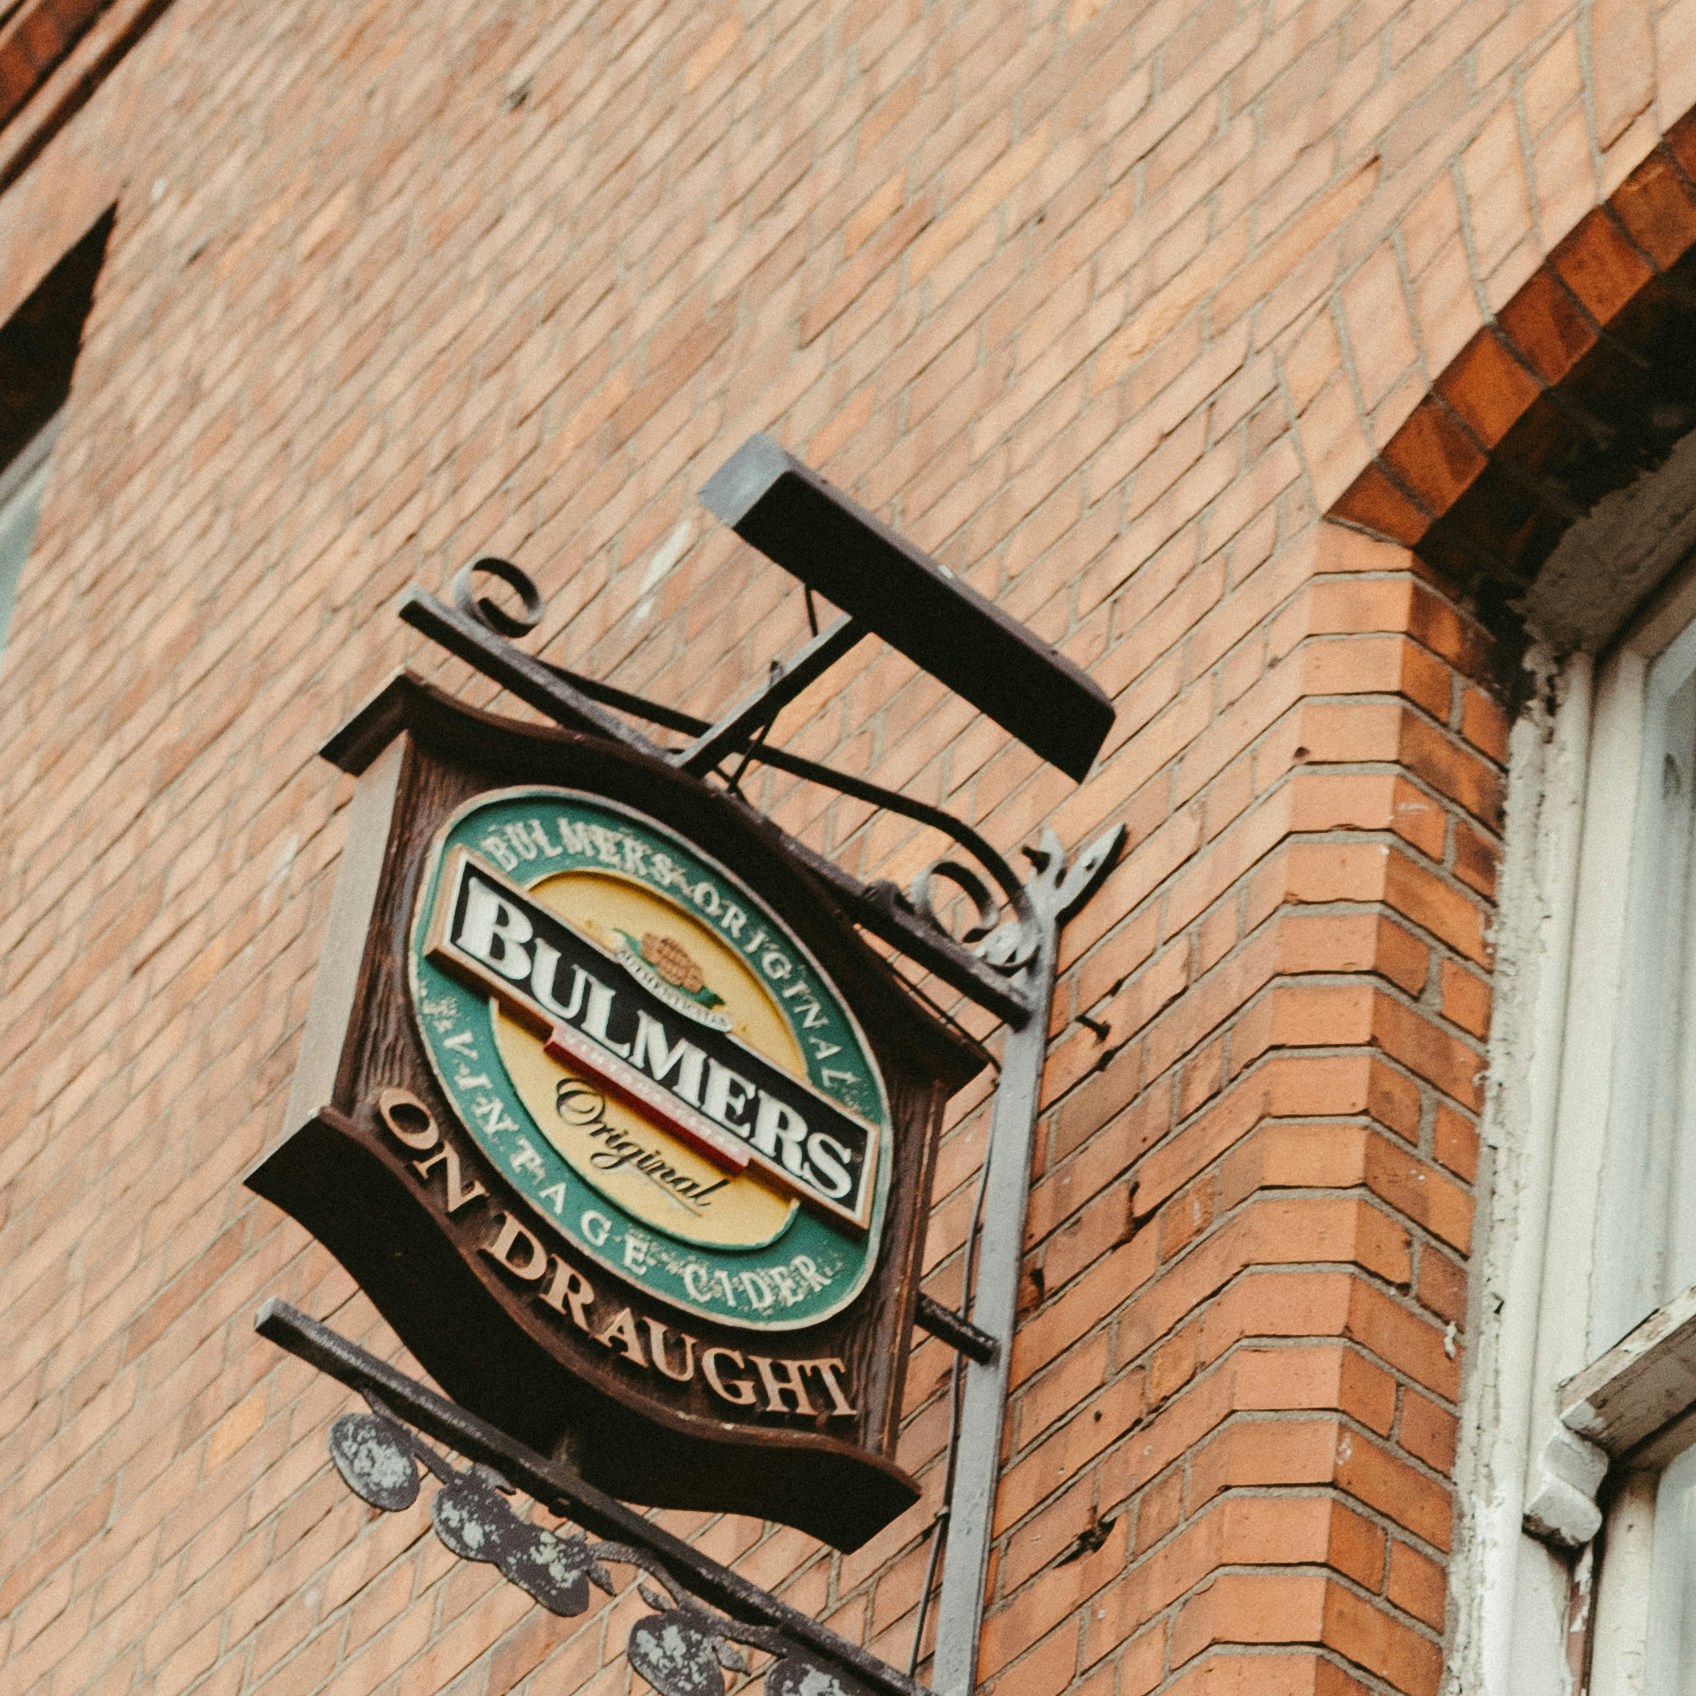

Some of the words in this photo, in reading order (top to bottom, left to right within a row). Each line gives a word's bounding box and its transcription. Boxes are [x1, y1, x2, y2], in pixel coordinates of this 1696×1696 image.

[456, 875, 855, 1200] BULMERS
[481, 815, 674, 886] BULMERS
[693, 881, 856, 1090] ORIGINAL
[380, 1087, 489, 1214] ON
[479, 1210, 858, 1417] DRAUGHT
[444, 1032, 650, 1276] VINTAGE
[684, 1254, 832, 1312] CIDER
[556, 1077, 731, 1208] Original
